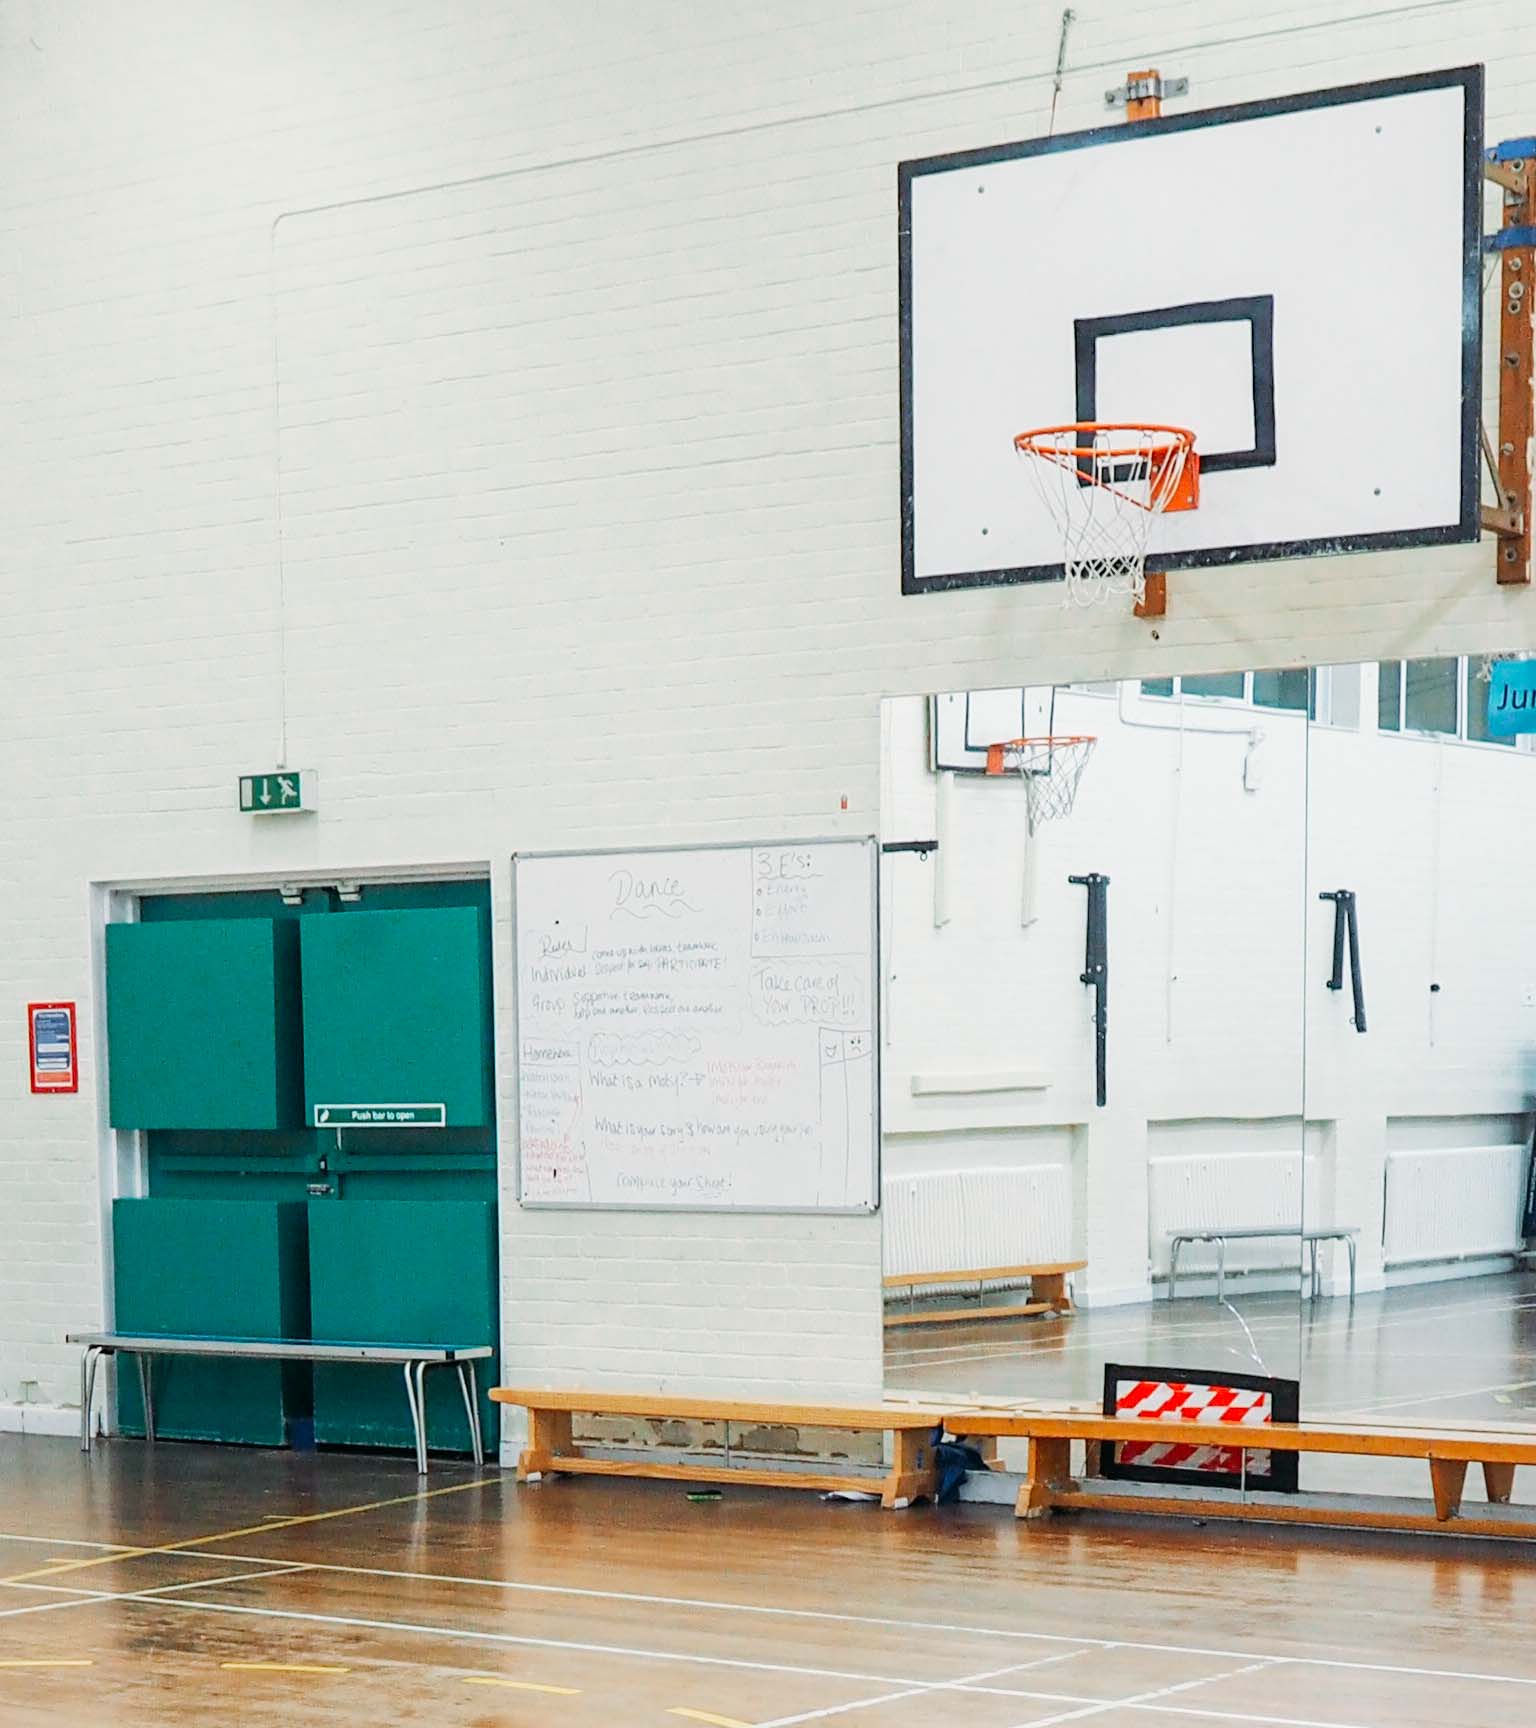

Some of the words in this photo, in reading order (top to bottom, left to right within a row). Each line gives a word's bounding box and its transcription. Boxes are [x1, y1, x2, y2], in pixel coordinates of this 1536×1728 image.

[757, 852, 772, 876] 3
[351, 1110, 372, 1121] Push
[372, 1110, 386, 1121] bar
[386, 1111, 395, 1121] to
[396, 1111, 415, 1122] open
